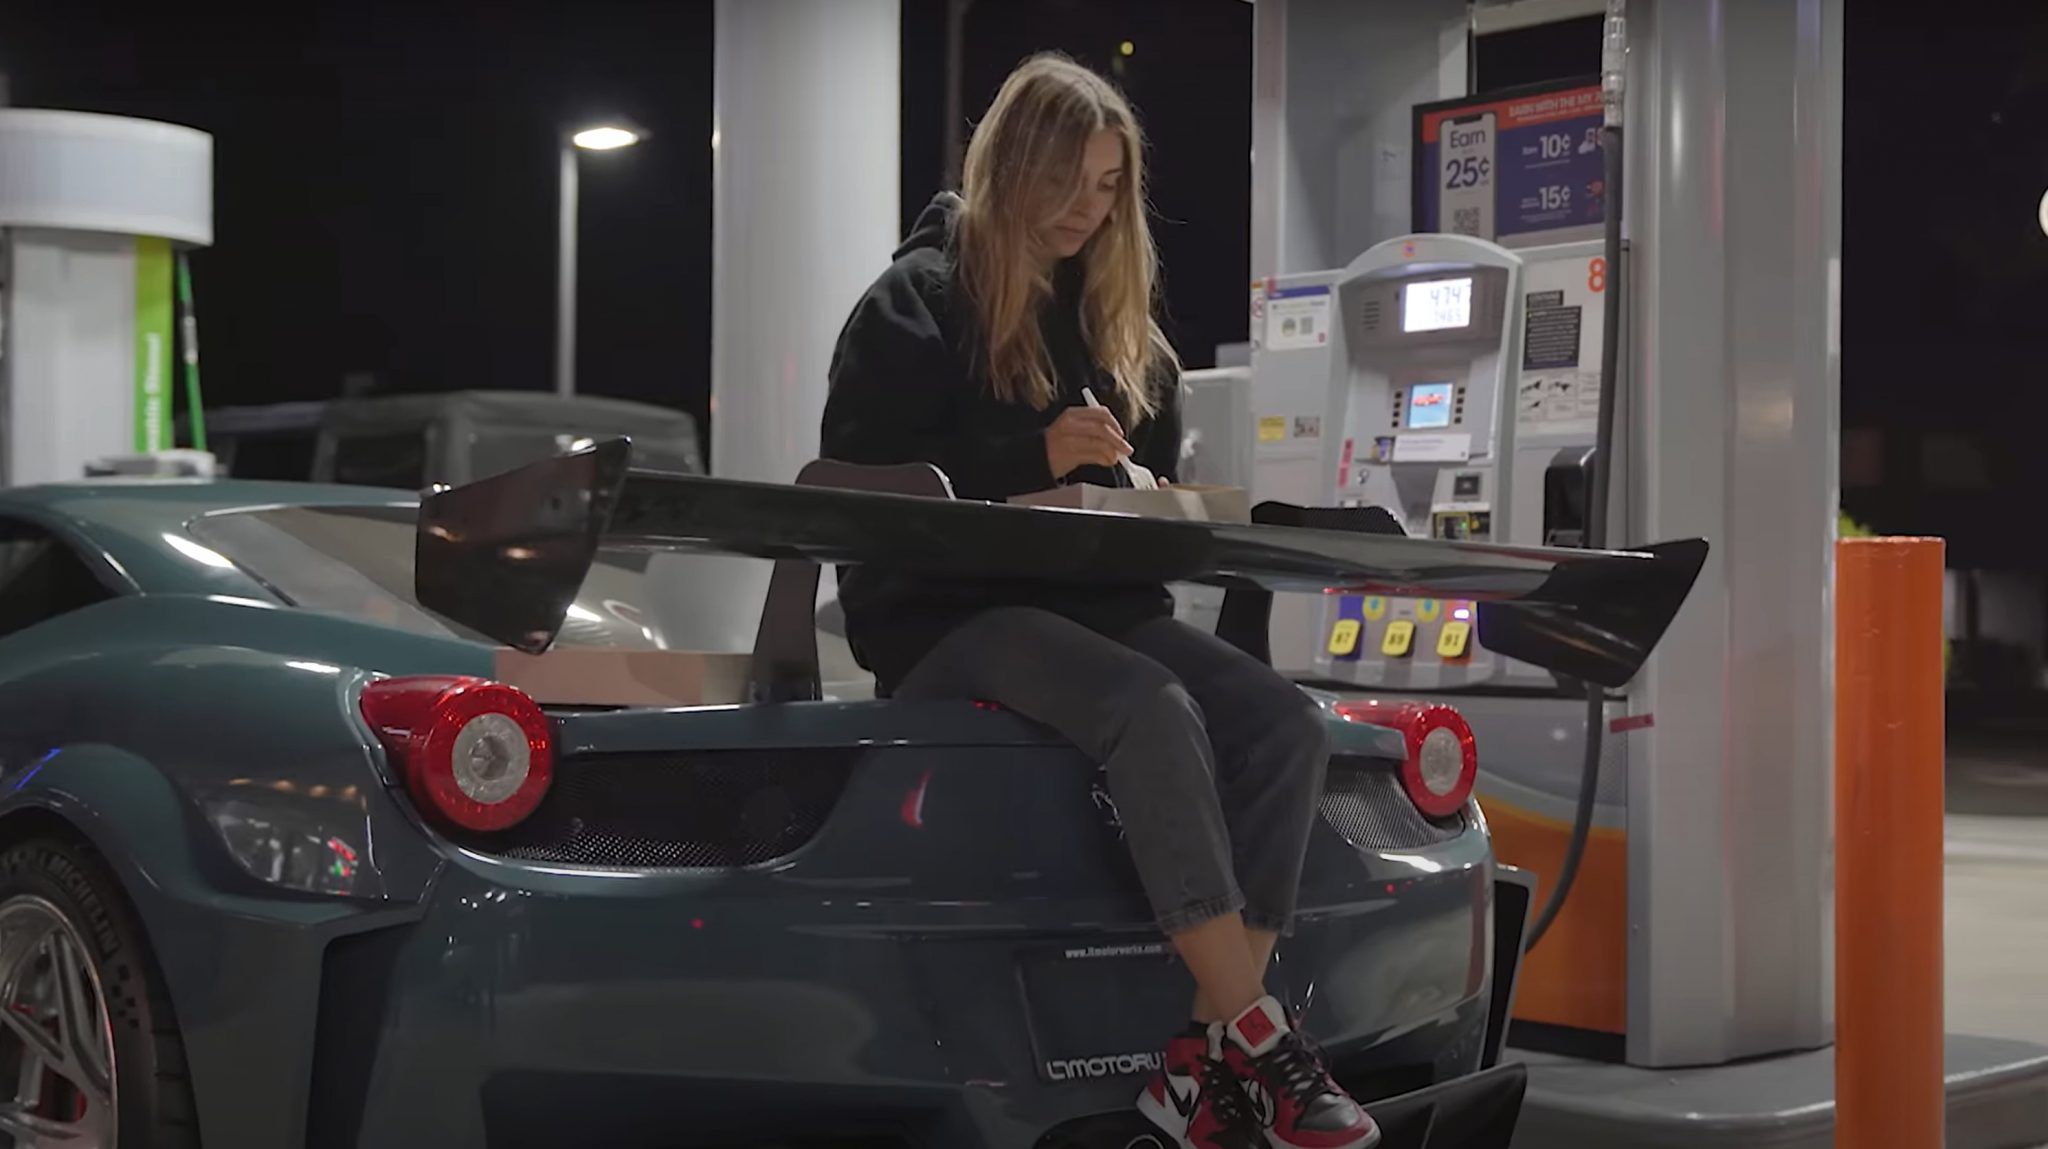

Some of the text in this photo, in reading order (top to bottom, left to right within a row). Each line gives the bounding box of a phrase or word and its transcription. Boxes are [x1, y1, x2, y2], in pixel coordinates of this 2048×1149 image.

[1450, 129, 1486, 149] Earn
[1539, 134, 1571, 160] 10¢
[1446, 156, 1490, 190] 25¢
[1538, 185, 1571, 211] 15¢
[1587, 257, 1606, 293] 8
[1389, 633, 1405, 646] 89
[1444, 633, 1460, 647] 91
[46, 854, 119, 953] MICHELIN
